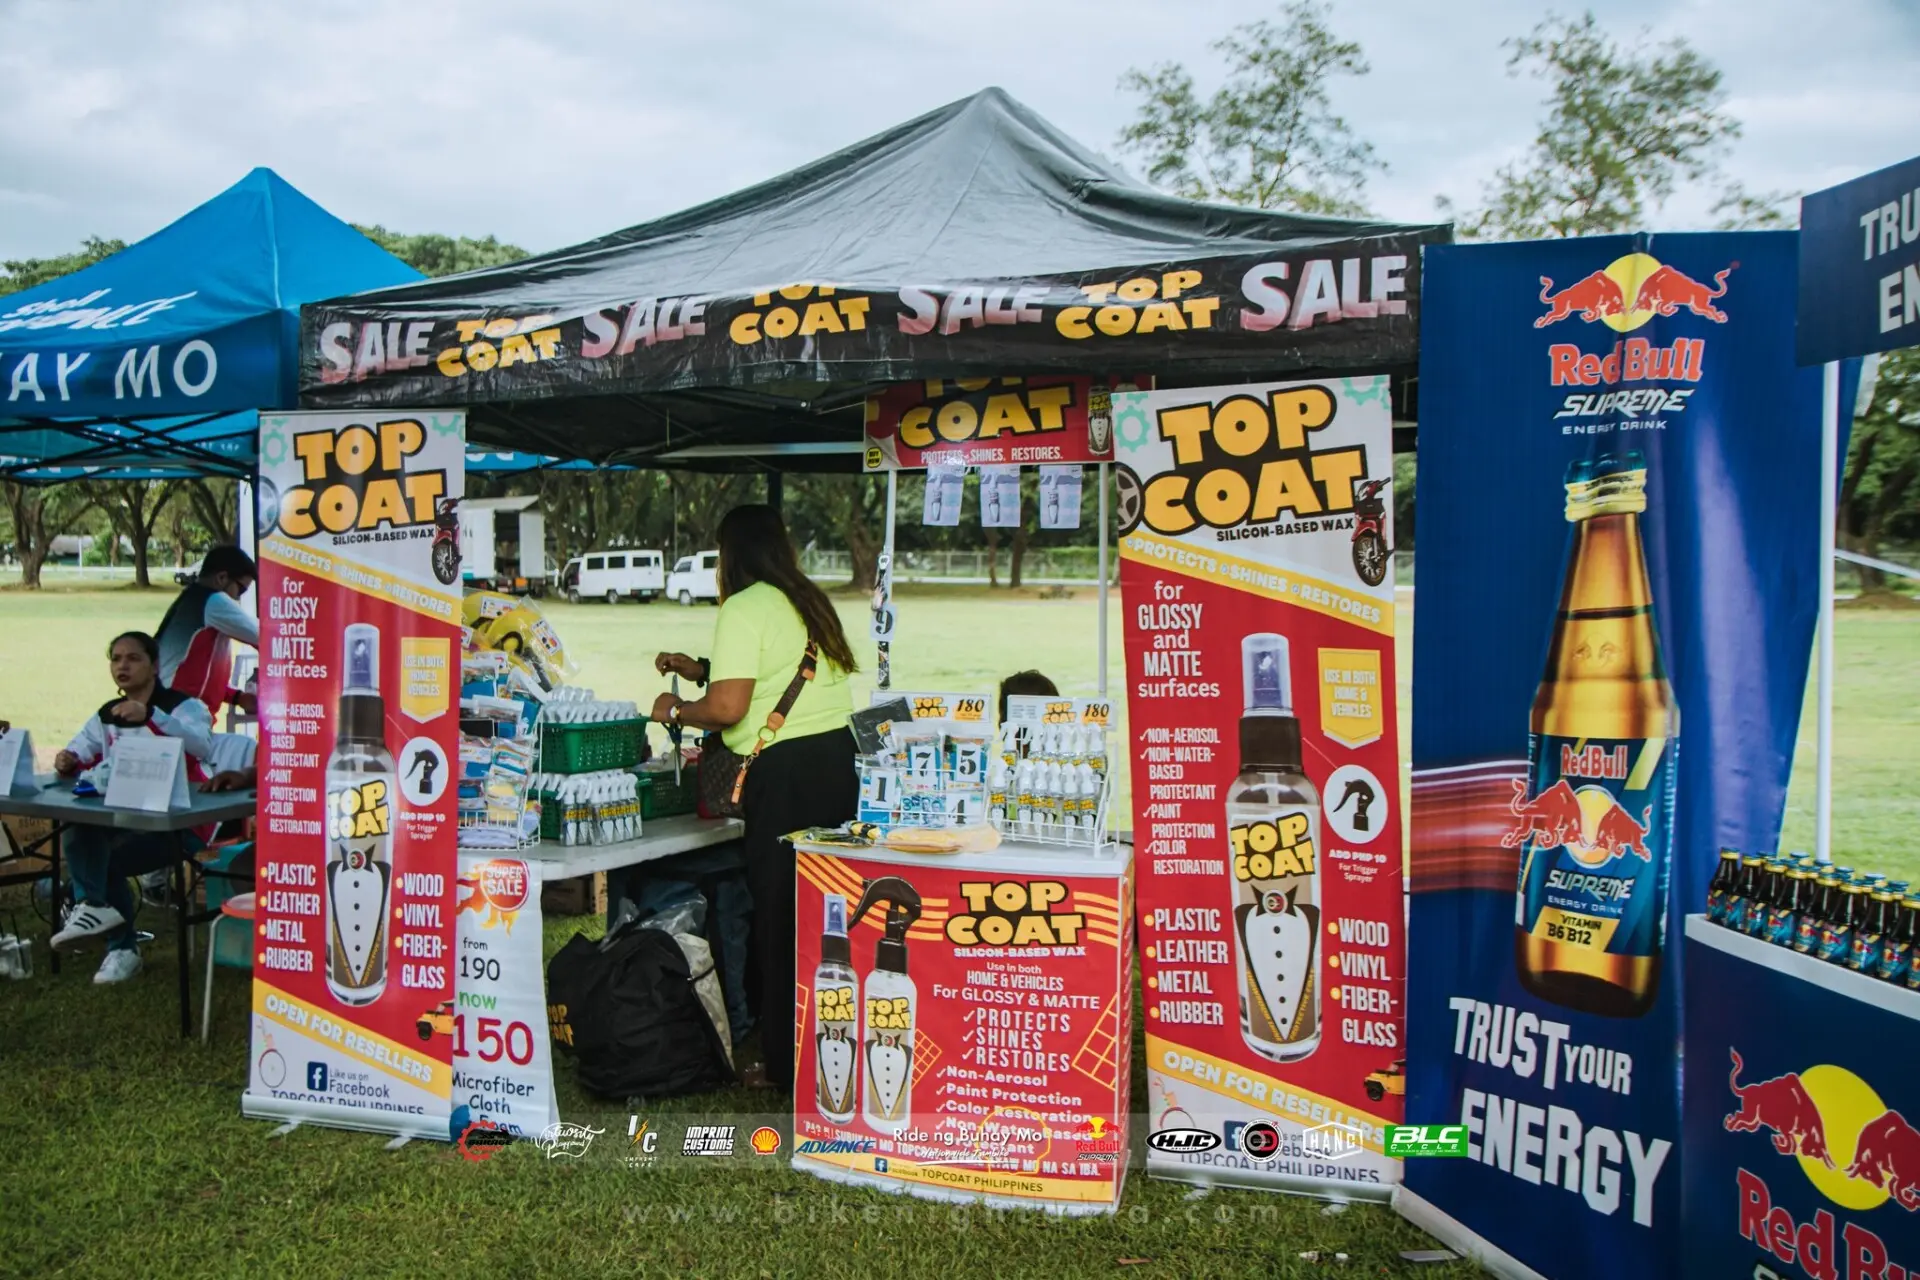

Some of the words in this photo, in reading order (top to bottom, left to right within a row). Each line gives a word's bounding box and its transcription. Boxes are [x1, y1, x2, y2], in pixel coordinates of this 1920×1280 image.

[1082, 270, 1203, 302] TOP
[1241, 255, 1407, 332] SALE
[730, 298, 870, 345] COAT
[898, 285, 1049, 335] SALE
[1055, 296, 1220, 340] COAT
[581, 298, 706, 357] SALE
[320, 322, 435, 383] SALE
[435, 329, 561, 377] COAT
[1548, 340, 1623, 385] Red
[1623, 337, 1705, 382] Bull
[0, 352, 91, 401] AY
[114, 340, 218, 399] MO
[1553, 389, 1695, 418] SUPREME
[900, 386, 1071, 448] COAT
[1158, 388, 1334, 465] TOP
[1562, 424, 1615, 434] ENERGY
[1620, 421, 1667, 430] DRINK
[295, 420, 425, 480] TOP
[1011, 446, 1063, 461] RESTORES.
[1142, 449, 1366, 534] COAT
[279, 474, 443, 536] COAT
[332, 531, 407, 545] SILICON-BASED
[410, 528, 435, 539] WAX
[1217, 520, 1319, 543] SILICON-BASED
[1321, 517, 1354, 532] WAX
[283, 577, 304, 594] for
[1134, 539, 1217, 574] PROTECTS
[1228, 565, 1288, 593] SHINES
[1300, 584, 1381, 624] RESTORES
[1154, 580, 1184, 600] for
[270, 597, 318, 620] GLOSSY
[1137, 604, 1203, 630] GLOSSY
[279, 619, 306, 636] and
[1153, 628, 1190, 650] and
[272, 637, 315, 660] MATTE
[266, 661, 327, 679] surfaces
[1143, 651, 1203, 677] MATTE
[1138, 677, 1220, 698] surfaces
[912, 707, 948, 717] COAT
[913, 697, 943, 707] TOP
[957, 699, 985, 712] 180
[1046, 703, 1072, 713] TOP
[1085, 704, 1109, 717] 180
[1042, 712, 1076, 724] COAT
[271, 735, 295, 749] BASED
[1147, 728, 1221, 744] NON-AEROSOL
[271, 752, 319, 767] PROTECTANT
[916, 752, 931, 777] 7
[960, 750, 976, 775] 5
[1148, 747, 1215, 763] NON-WATER-
[1561, 743, 1591, 777] Red
[1591, 744, 1628, 779] Bull
[270, 769, 292, 783] PAINT
[1149, 764, 1183, 780] BASED
[270, 787, 316, 802] PROTECTION
[328, 779, 387, 816] TOP
[1150, 783, 1217, 801] PROTECTANT
[270, 801, 294, 816] COLOR
[1151, 803, 1181, 819] PAINT
[270, 818, 321, 835] RESTORATION
[1152, 822, 1215, 839] PROTECTION
[1230, 812, 1309, 848] TOP
[1152, 839, 1187, 855] COLOR
[486, 865, 523, 879] SUPER
[1153, 858, 1224, 876] RESTORATION
[1233, 841, 1316, 881] COAT
[1339, 862, 1351, 873] For
[1352, 864, 1378, 875] Trigger
[267, 861, 316, 886] PLASTIC
[404, 873, 444, 898] WOOD
[1344, 871, 1374, 883] Sprayer
[487, 878, 523, 896] SALE
[961, 881, 1068, 912] TOP
[1544, 870, 1635, 902] SUPREME
[267, 891, 320, 916] LEATHER
[403, 903, 443, 928] VINYL
[1548, 895, 1587, 910] ENERGY
[1591, 904, 1623, 915] DRINK
[266, 919, 306, 943] METAL
[946, 914, 1084, 945] COAT
[1154, 908, 1221, 933] PLASTIC
[1338, 917, 1390, 947] WOOD
[1561, 914, 1602, 930] VITAMIN
[463, 936, 488, 950] from
[1547, 922, 1564, 939] B6
[1567, 926, 1592, 945] B12
[403, 933, 447, 959] FIBER-
[954, 948, 1050, 958] SILICON-BASED
[1052, 947, 1086, 956] WAX
[1156, 940, 1228, 964] LEATHER
[266, 947, 313, 972] RUBBER
[460, 956, 500, 981] 190
[987, 962, 1005, 971] Use
[1007, 962, 1016, 972] in
[1018, 963, 1042, 974] both
[1339, 951, 1391, 981] VINYL
[402, 964, 445, 990] GLASS
[967, 970, 998, 987] HOME
[1000, 974, 1009, 987] &
[1011, 974, 1064, 991] VEHICLES
[1158, 970, 1213, 994] METAL
[459, 990, 496, 1010] now
[816, 986, 853, 1006] TOP
[867, 997, 909, 1015] TOP
[933, 984, 958, 999] For
[962, 988, 1025, 1005] GLOSSY
[1028, 993, 1039, 1006] &
[1044, 994, 1100, 1009] MATTE
[1341, 984, 1399, 1014] FIBER-
[976, 1008, 1071, 1033] PROTECTS
[1160, 1001, 1224, 1026] RUBBER
[266, 994, 309, 1027] OPEN
[311, 1014, 342, 1044] FOR
[345, 1028, 433, 1084] RESELLERS
[453, 1014, 534, 1065] 150
[976, 1026, 1042, 1050] SHINES
[1342, 1018, 1397, 1048] GLASS
[1449, 997, 1571, 1091] TRUST
[1563, 1043, 1632, 1095] YOUR
[976, 1047, 1070, 1072] RESTORES
[329, 1069, 345, 1080] Like
[350, 1072, 357, 1080] us
[358, 1073, 369, 1081] on
[452, 1072, 535, 1097] Microfiber
[947, 1066, 1048, 1087] Non-Aerosol
[329, 1079, 390, 1098] Facebook
[947, 1083, 988, 1098] Paint
[992, 1088, 1082, 1106] Protection
[1163, 1051, 1221, 1086] OPEN
[1224, 1073, 1266, 1102] FOR
[1272, 1089, 1385, 1146] RESELLERS
[469, 1094, 511, 1115] Cloth
[946, 1100, 989, 1116] Color
[995, 1106, 1093, 1124] Restoration
[1043, 1162, 1057, 1174] NA
[1062, 1162, 1076, 1175] SA
[1461, 1087, 1673, 1228] ENERGY
[920, 1167, 971, 1185] TOPCOAT
[974, 1176, 1043, 1192] PHILIPPINES
[1736, 1167, 1839, 1280] Red
